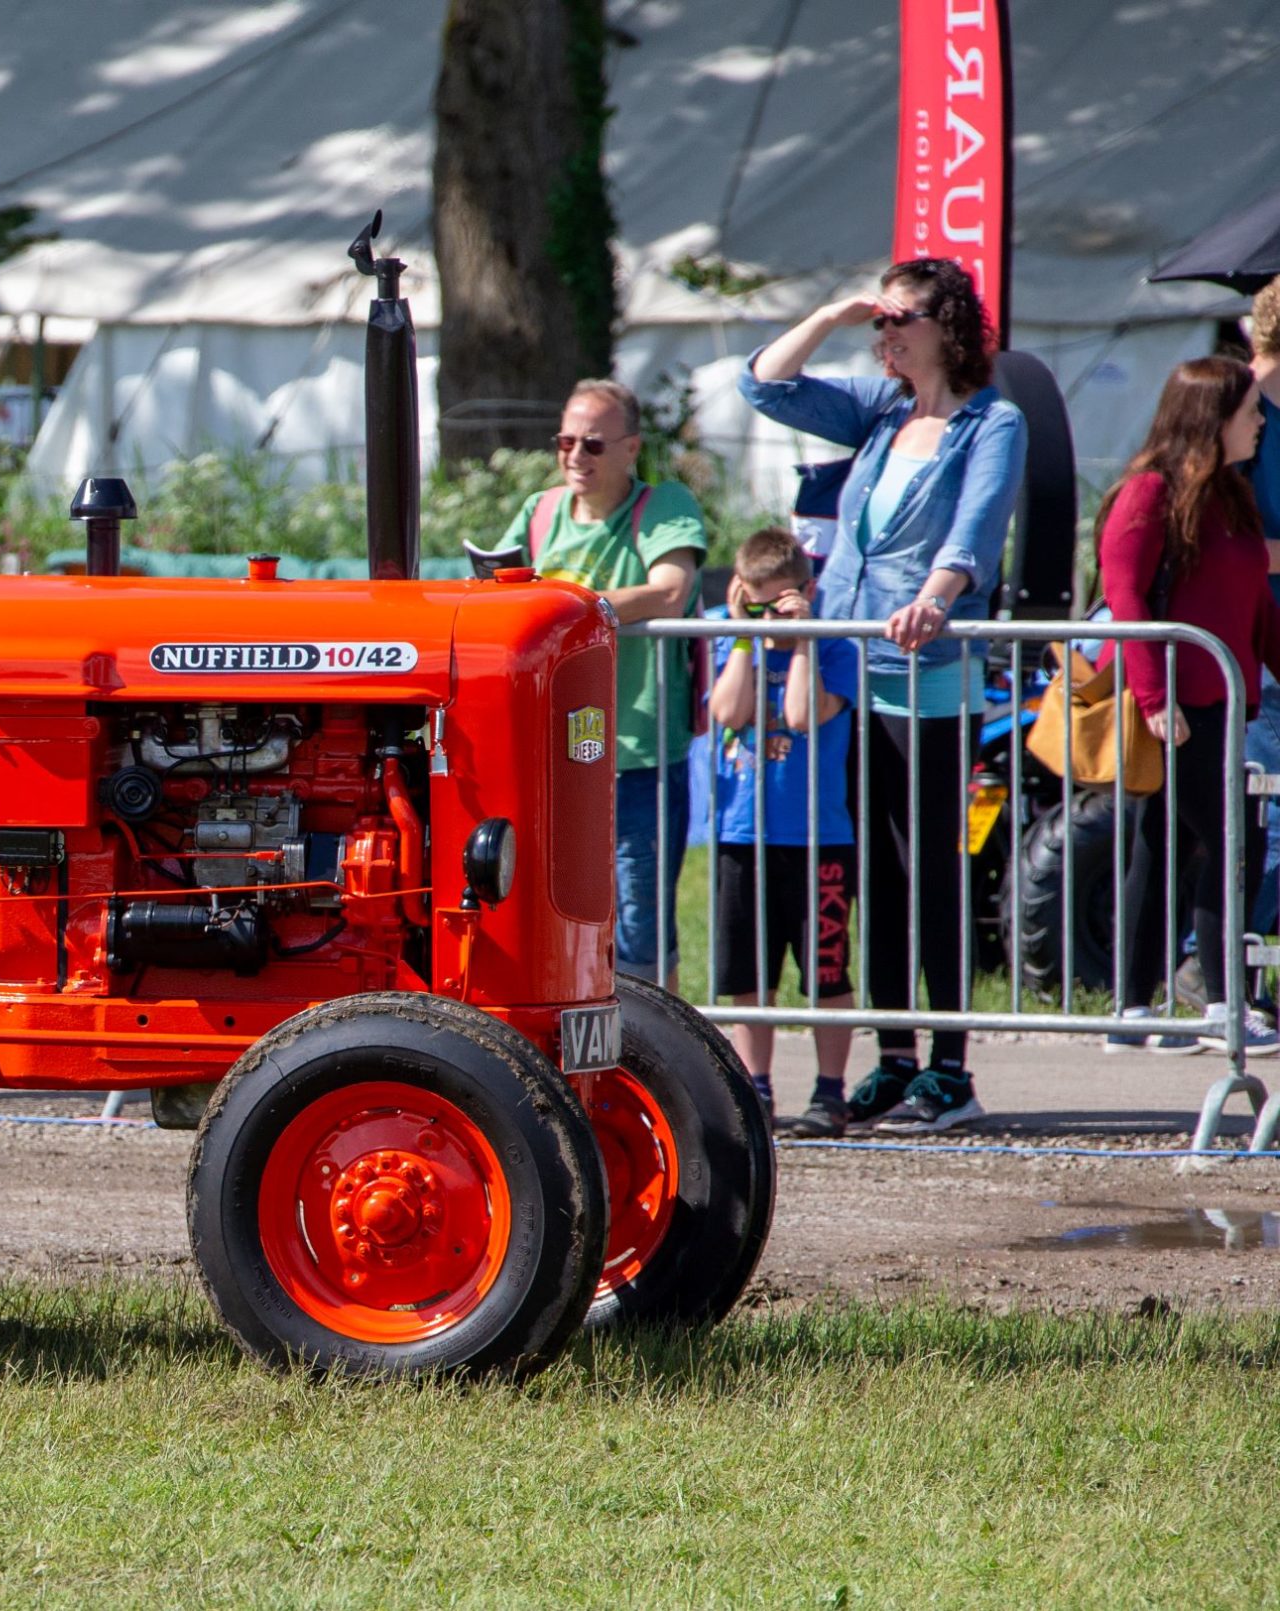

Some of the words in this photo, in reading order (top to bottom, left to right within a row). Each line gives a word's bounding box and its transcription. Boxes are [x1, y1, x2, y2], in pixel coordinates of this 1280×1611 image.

[161, 647, 309, 668] NUFFIELD
[325, 647, 402, 667] 10/42
[817, 862, 848, 984] SKATE
